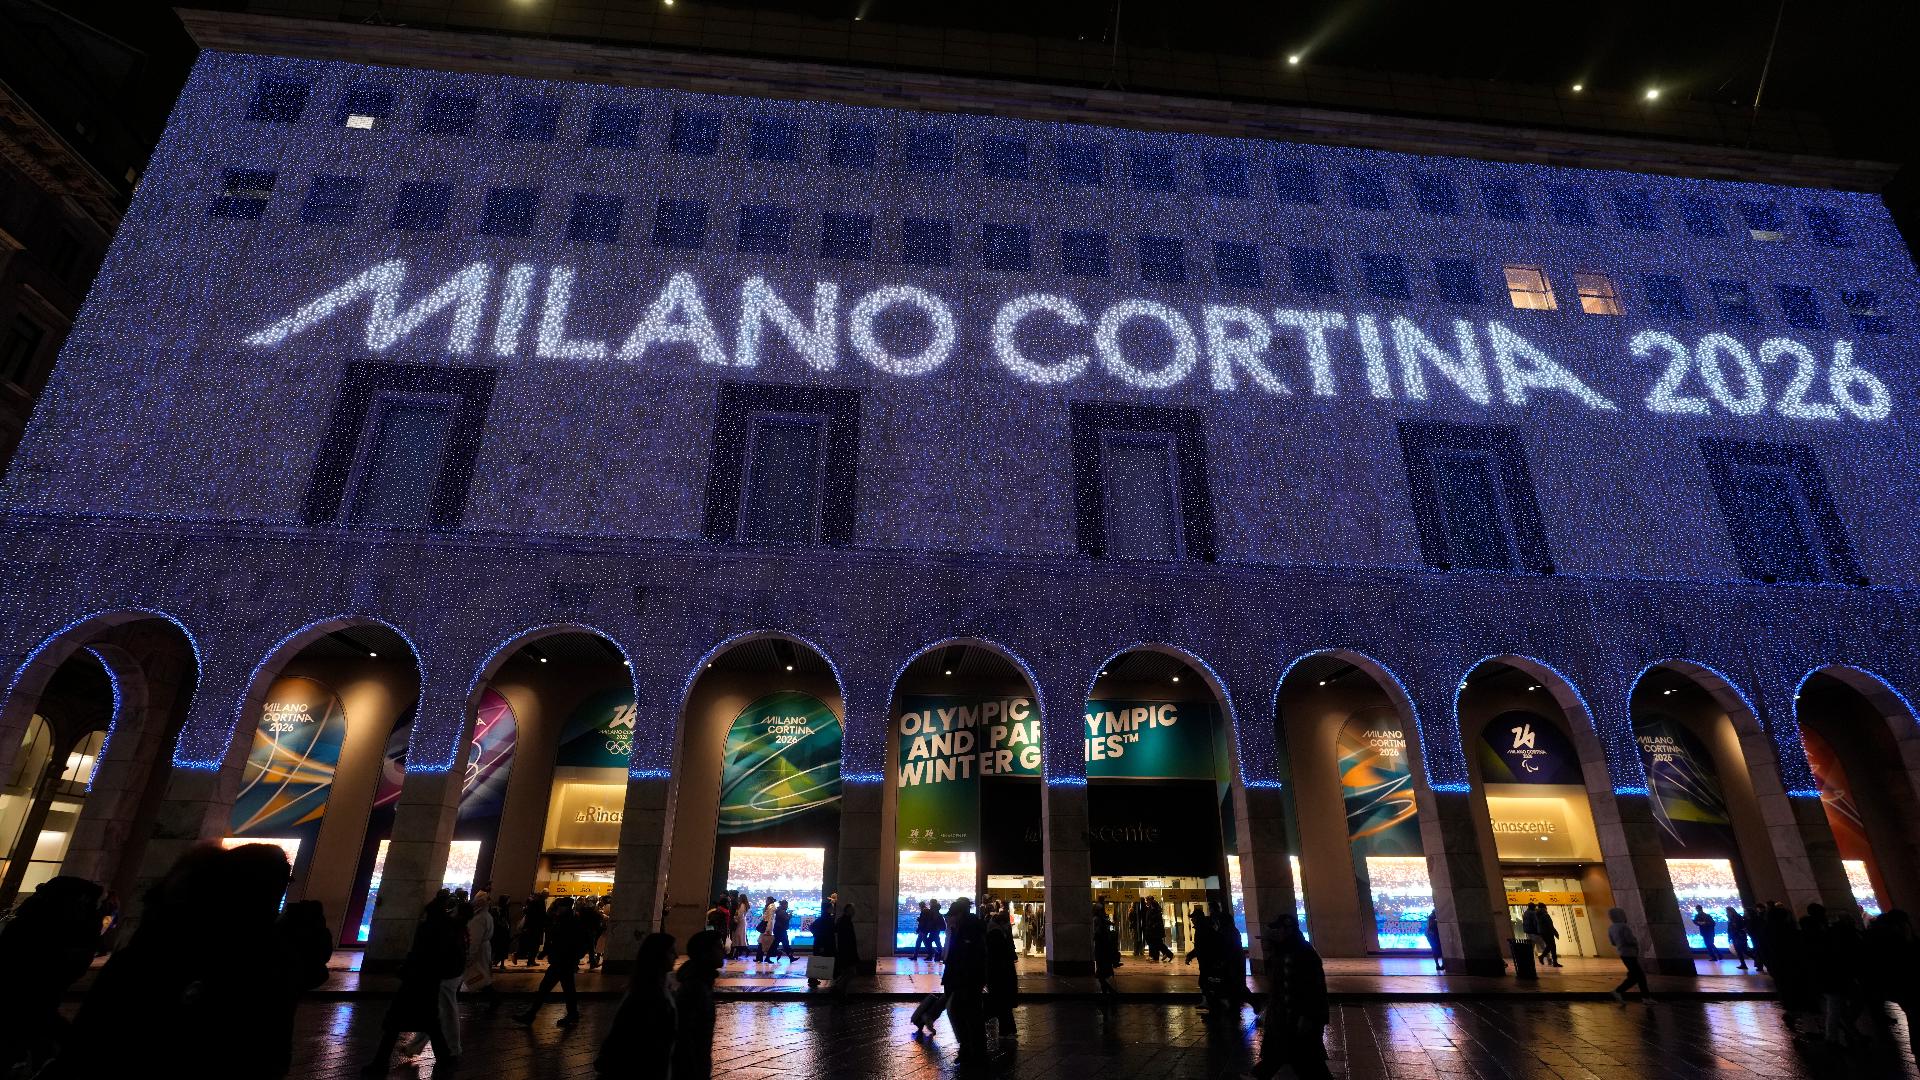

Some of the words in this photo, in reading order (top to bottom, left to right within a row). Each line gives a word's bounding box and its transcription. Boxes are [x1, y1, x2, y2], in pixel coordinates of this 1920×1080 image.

[244, 260, 956, 376] MILANO
[991, 293, 1618, 412] CORTINA
[1629, 329, 1892, 422] 2026
[263, 702, 309, 713] MILANO
[263, 712, 315, 723] CORTINA
[760, 715, 807, 725] MILANO
[900, 698, 1030, 736] OLYMPIC
[268, 722, 294, 732] 2026
[767, 725, 816, 735] CORTINA
[775, 735, 798, 744] 2026
[1362, 730, 1403, 739] MILANO
[1637, 735, 1674, 745] MILANO
[907, 730, 975, 761] AND
[1643, 744, 1685, 753] CORTINA
[1379, 748, 1400, 757] 2026
[1653, 753, 1673, 762] 2026
[898, 748, 1013, 788] WINTER
